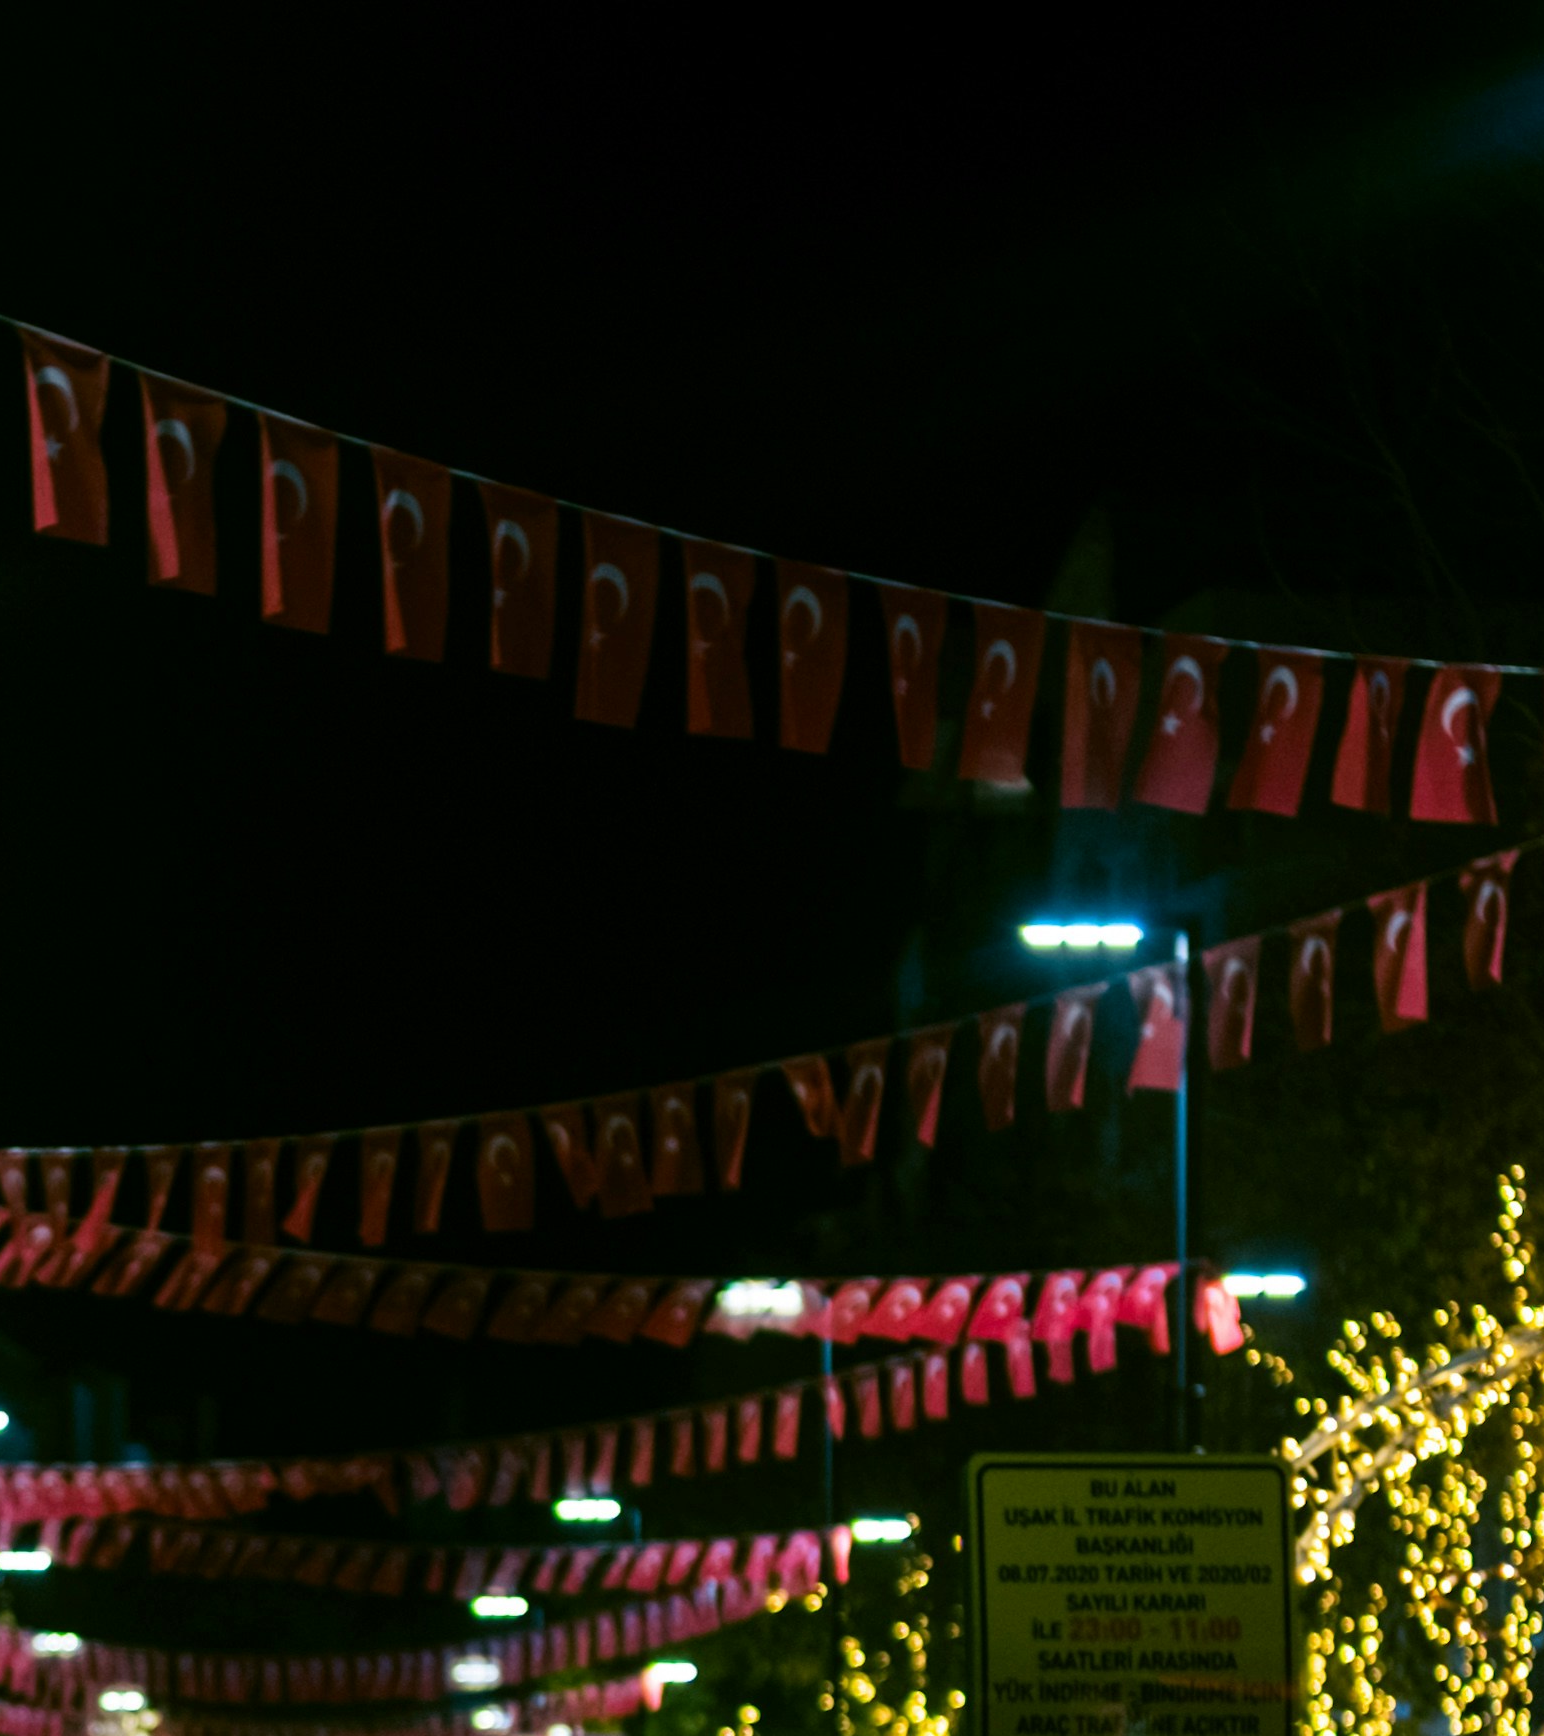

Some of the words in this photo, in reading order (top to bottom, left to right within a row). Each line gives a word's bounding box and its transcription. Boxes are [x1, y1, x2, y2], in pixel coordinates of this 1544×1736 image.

[1090, 1479, 1118, 1497] BU
[1123, 1479, 1176, 1497] ALAN
[1003, 1507, 1056, 1528] UŞAK
[1062, 1505, 1080, 1526] İL
[1085, 1505, 1156, 1526] TRAFİK
[1162, 1505, 1264, 1526] KOMİSYON
[1075, 1532, 1195, 1556] BAŞKANLIĞI
[1104, 1560, 1163, 1584] TARİH
[1167, 1564, 1192, 1584] VE
[1065, 1593, 1128, 1613] SAYILI
[1132, 1593, 1207, 1613] KARARI
[1032, 1617, 1063, 1641] İLE
[1038, 1648, 1133, 1671] SAATLERİ
[1138, 1650, 1238, 1671] ARASINDA
[993, 1678, 1034, 1702] YÜK
[1038, 1679, 1122, 1703] İNDİRME
[1016, 1714, 1070, 1736] ARAÇ
